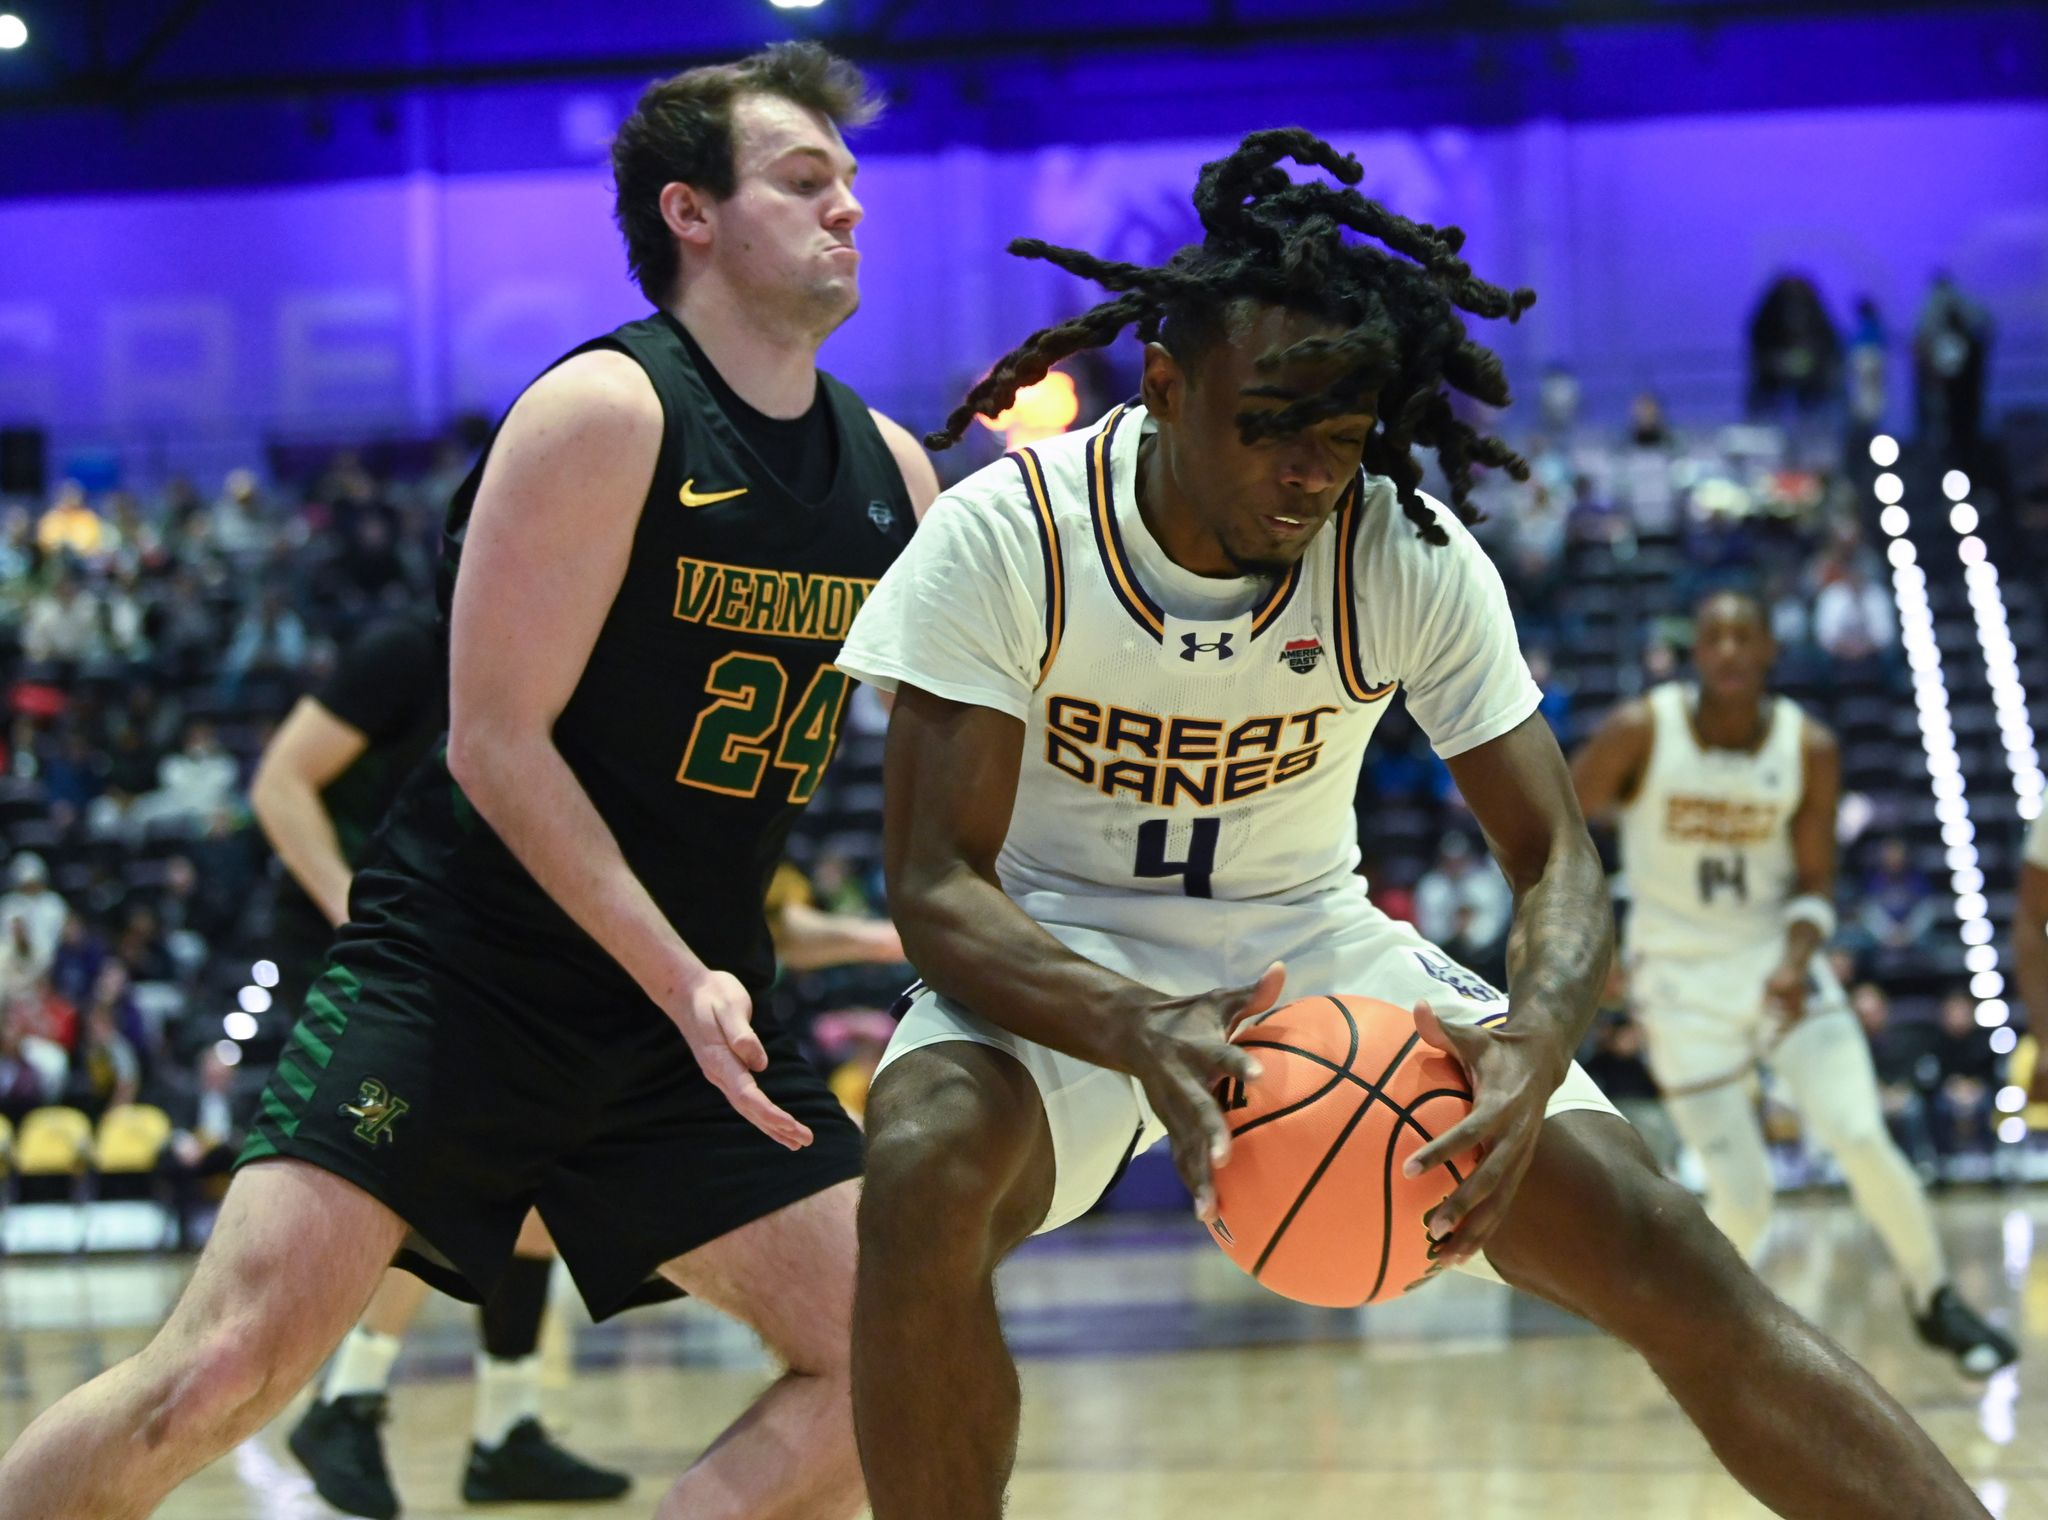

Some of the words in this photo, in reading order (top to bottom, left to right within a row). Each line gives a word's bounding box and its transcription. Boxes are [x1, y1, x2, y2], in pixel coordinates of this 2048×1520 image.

[1277, 645, 1325, 663] AMERICA
[1289, 656, 1317, 667] EAST
[675, 651, 849, 803] 24
[1045, 693, 1342, 761] GREAT
[1043, 726, 1326, 808] DANES
[1133, 817, 1220, 899] 4
